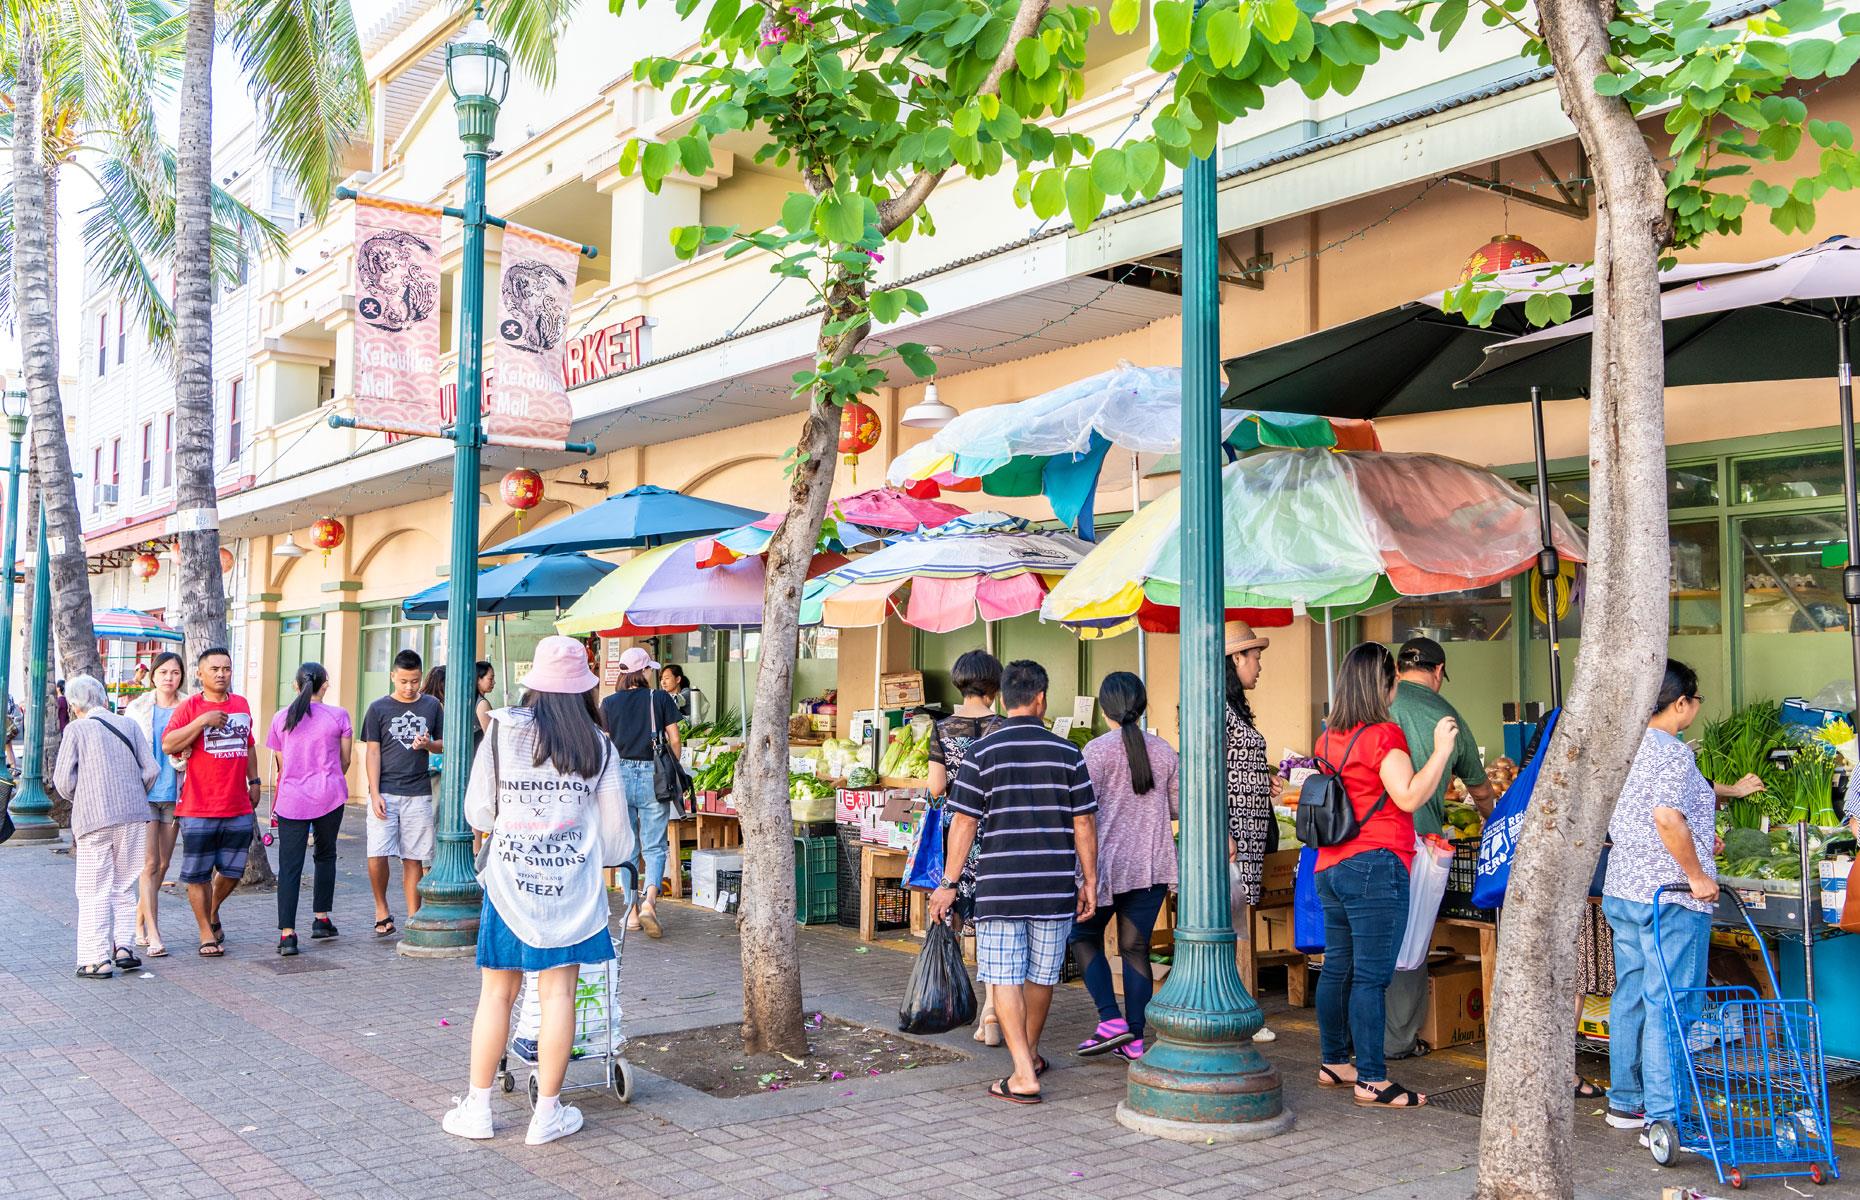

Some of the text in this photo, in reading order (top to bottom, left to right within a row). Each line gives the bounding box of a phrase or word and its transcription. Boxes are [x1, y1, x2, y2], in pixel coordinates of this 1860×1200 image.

[360, 342, 433, 375] Kekaulike
[562, 315, 646, 388] RKET
[361, 371, 393, 398] Mall
[495, 391, 528, 417] Mall
[502, 793, 581, 805] GUCCI
[549, 831, 582, 841] KLEIN
[499, 839, 578, 854] PRADA
[525, 853, 586, 867] SIMONS
[515, 879, 564, 897] YEEZY
